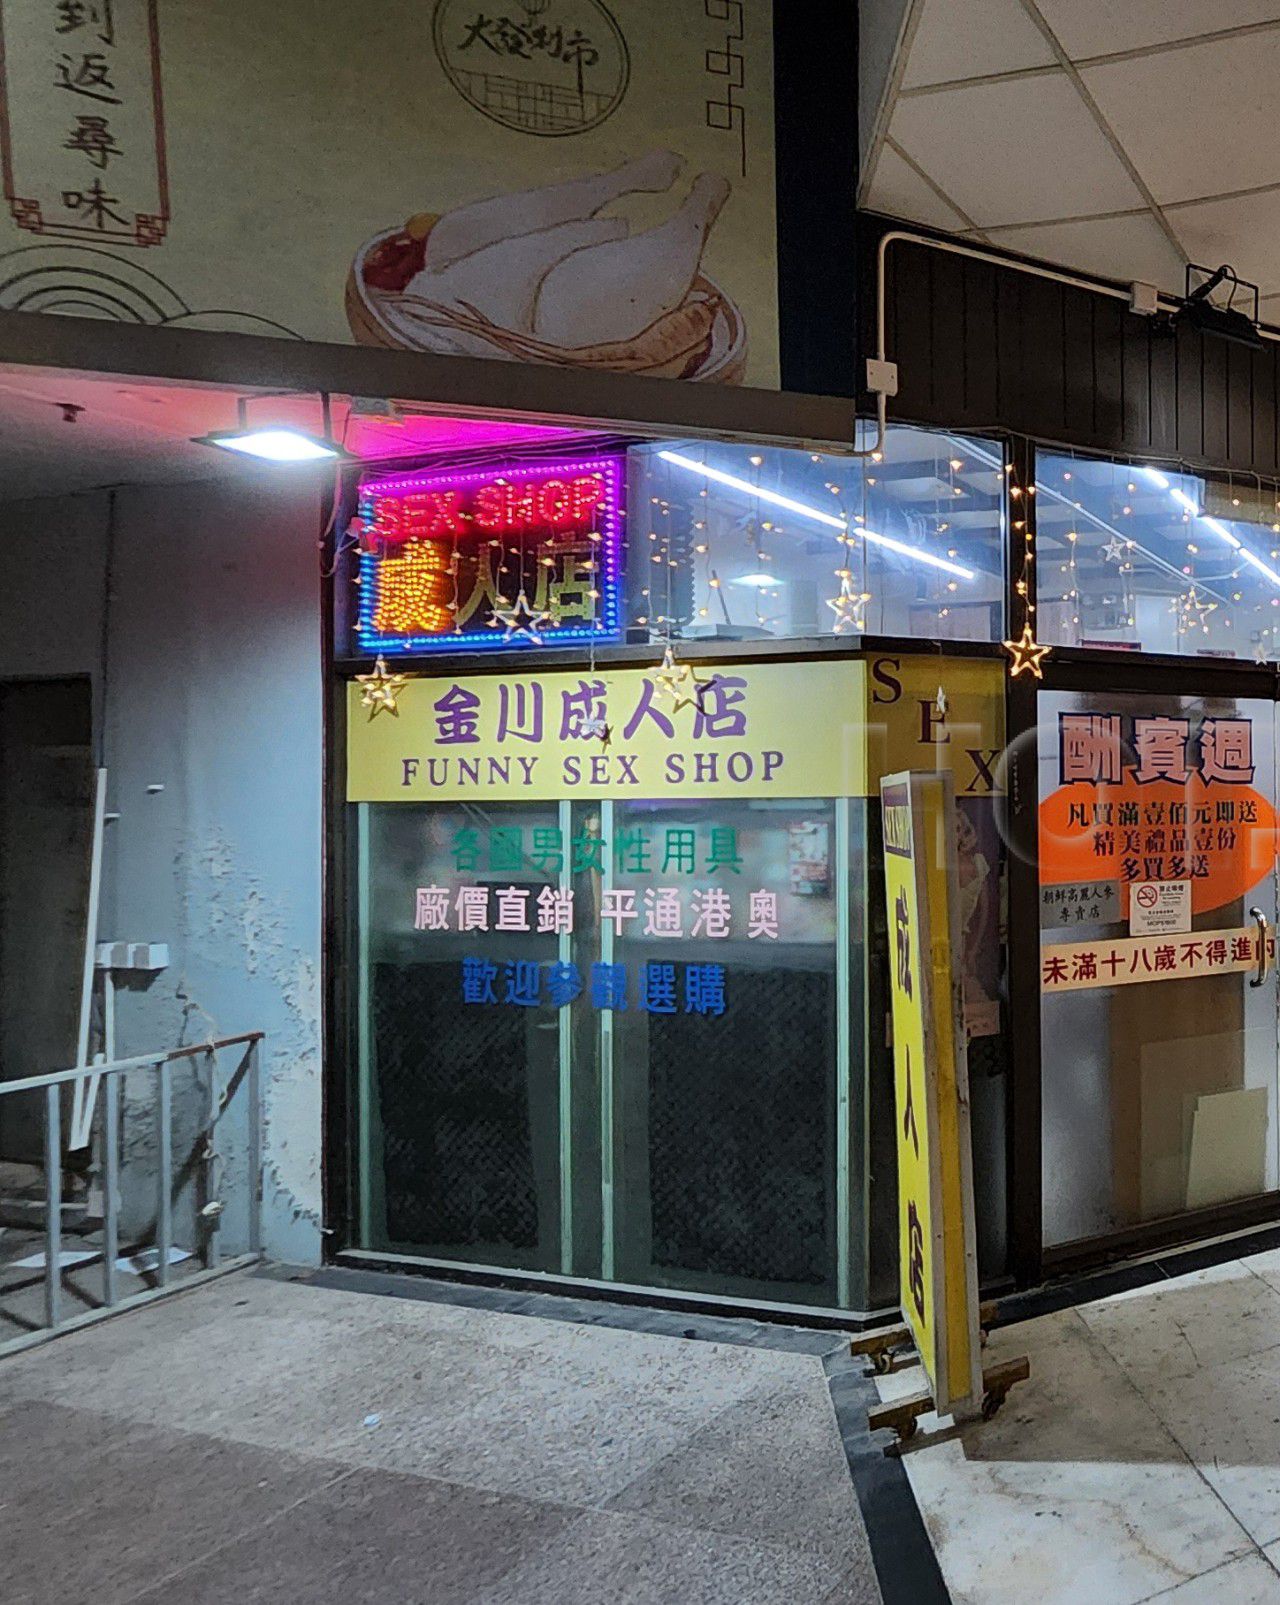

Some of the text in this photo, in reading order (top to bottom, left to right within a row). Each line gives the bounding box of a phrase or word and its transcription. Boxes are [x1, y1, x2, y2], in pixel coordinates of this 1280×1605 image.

[372, 475, 602, 536] SEX SHOP
[433, 673, 750, 747] 金川成人店
[402, 751, 785, 787] FUNNY SEX SHOP
[1059, 712, 1256, 787] 酬賓週
[1067, 800, 1258, 827] 凡買滿壹佰元即送
[450, 826, 745, 876] 各國男女性用具
[1092, 828, 1237, 856] 精美禮品壹份
[1120, 856, 1210, 882] 多買多送
[413, 885, 576, 935] 廠價直銷
